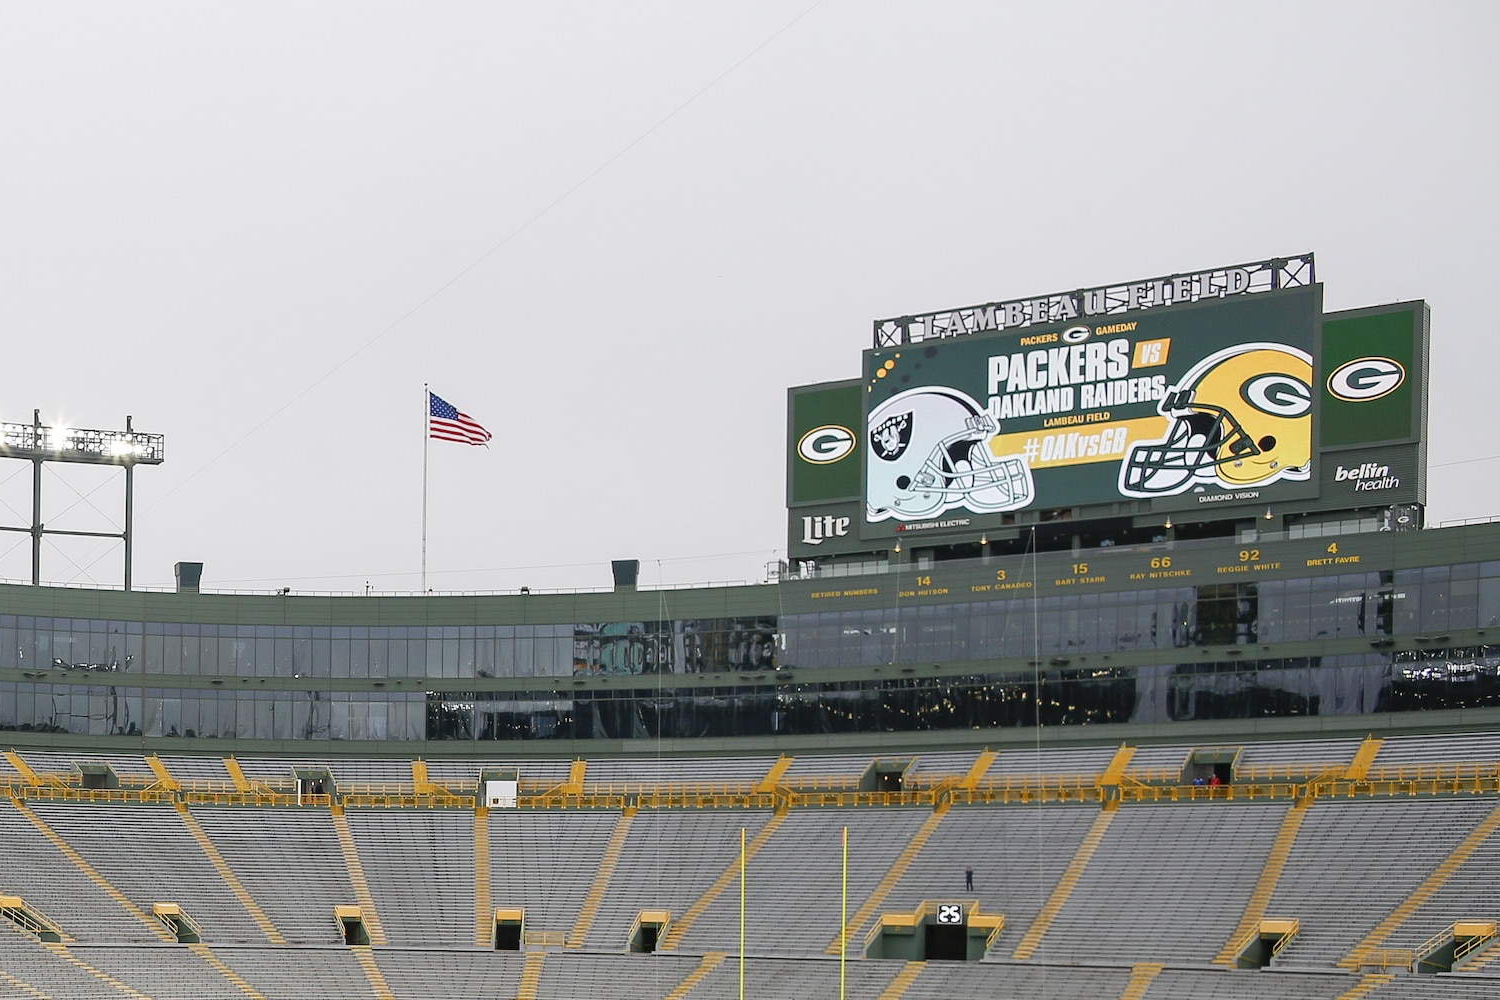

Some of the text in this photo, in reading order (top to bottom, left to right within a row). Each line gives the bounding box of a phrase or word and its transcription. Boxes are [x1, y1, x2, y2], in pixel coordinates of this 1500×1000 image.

[923, 268, 1250, 340] LAMBEAU FIELD
[1020, 333, 1058, 346] PACKERS
[1095, 322, 1137, 335] GAMEDAY
[988, 339, 1161, 394] PACKERS VS
[989, 374, 1166, 420] OAKLAND RAIDERS
[1043, 412, 1111, 428] LAMBEAU FIELD
[1022, 427, 1127, 462] #OAKvsGB
[1335, 462, 1389, 482] bellin
[1355, 475, 1400, 492] health
[1198, 491, 1260, 504] DIAMOND VISION
[802, 515, 851, 545] Lite
[905, 518, 970, 531] MITSUBISHI ELECTRIC
[1327, 543, 1338, 554] 4
[1239, 550, 1260, 562] 92
[1307, 555, 1360, 567] BRETT FAVRE
[1072, 563, 1088, 574] 15
[1150, 557, 1171, 568] 66
[1217, 562, 1281, 574] REGGIE WHITE
[997, 570, 1006, 581] 3
[1055, 575, 1106, 587] BART STARR
[1130, 569, 1192, 581] RAY NITSCHKE
[916, 576, 931, 587] 14
[971, 581, 1032, 593] TONY CANADEO
[811, 588, 878, 599] RETIRED NUMBERS
